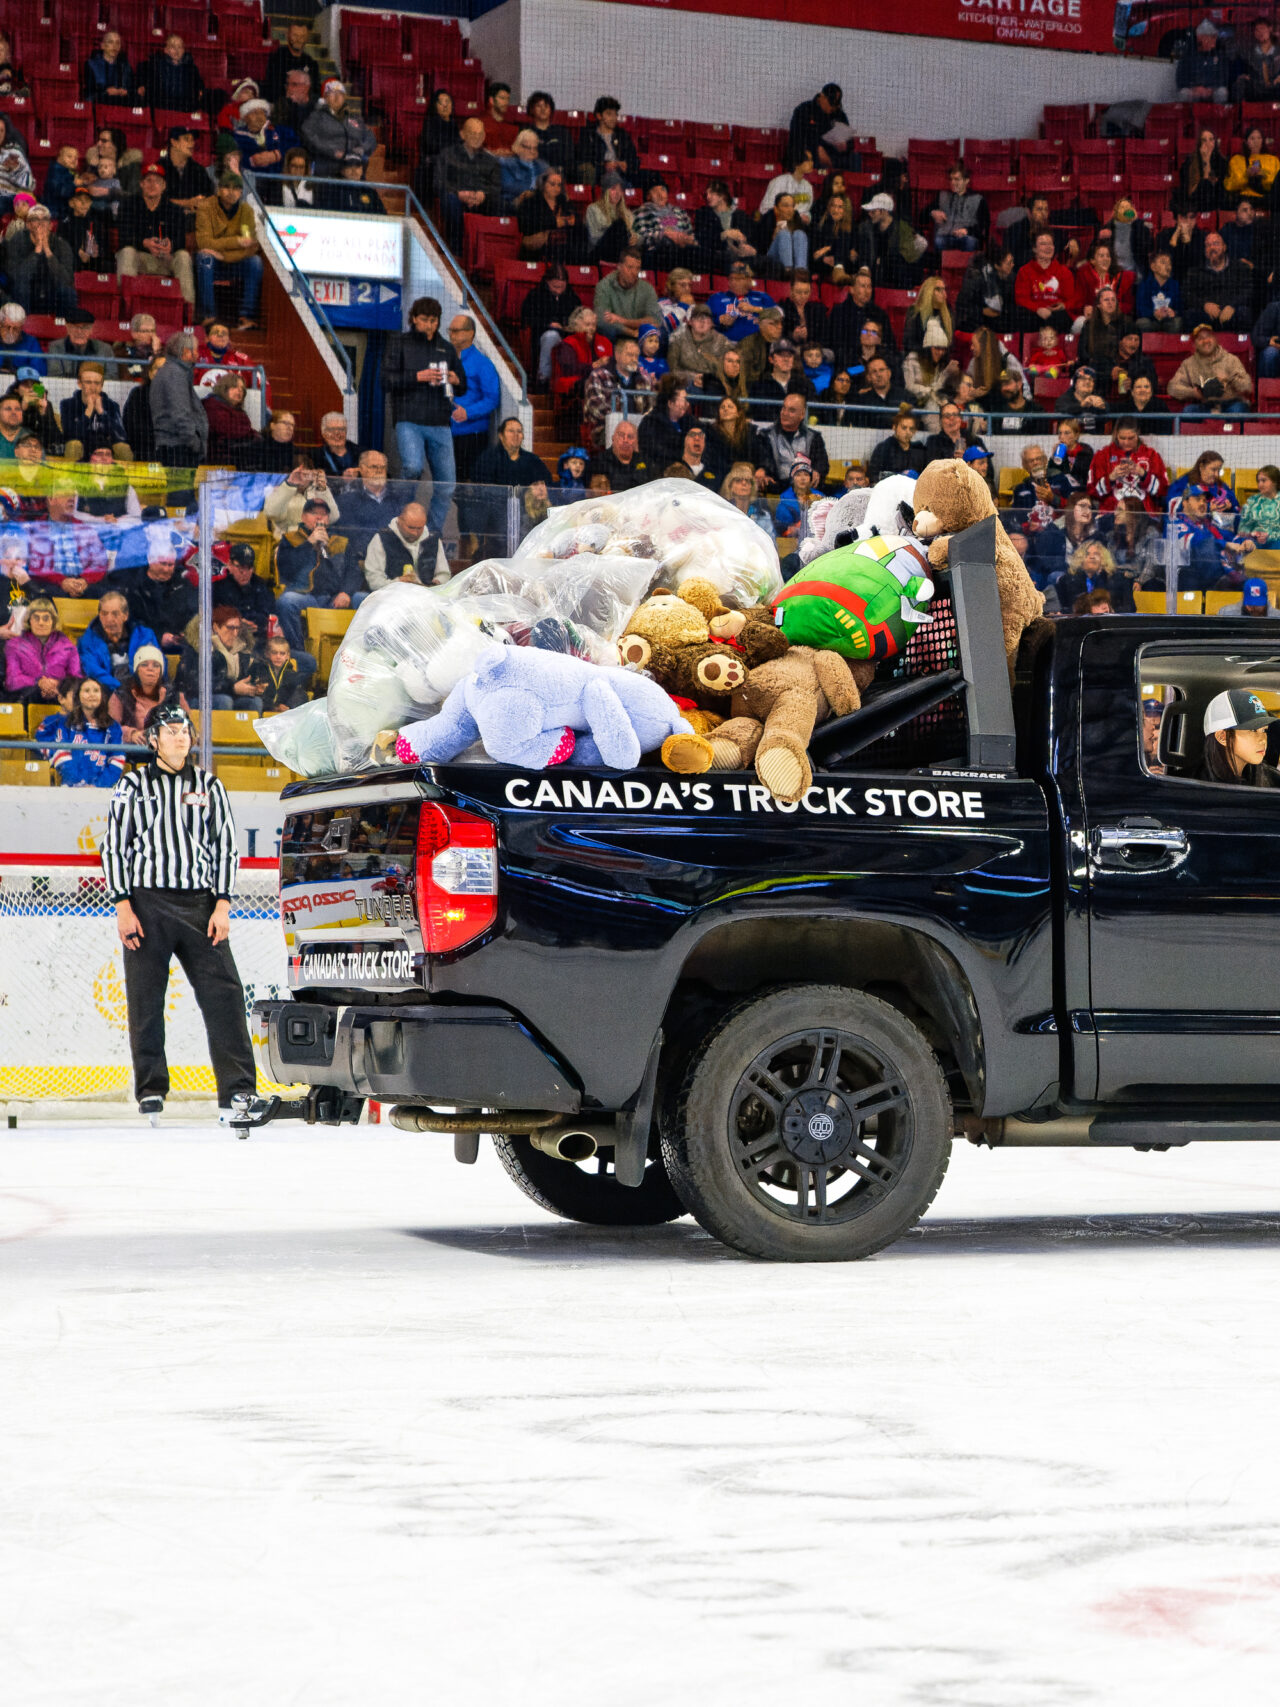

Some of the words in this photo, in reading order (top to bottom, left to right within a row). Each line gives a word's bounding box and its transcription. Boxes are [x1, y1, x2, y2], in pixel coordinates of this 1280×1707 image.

[313, 281, 344, 302] EXIT
[357, 282, 371, 302] 2
[932, 770, 1008, 779] BACKRACK
[723, 783, 857, 815] TRCK
[864, 788, 986, 819] STORE
[355, 895, 415, 920] TUNDRA
[347, 951, 379, 980] TRUCK
[381, 950, 415, 979] STORE
